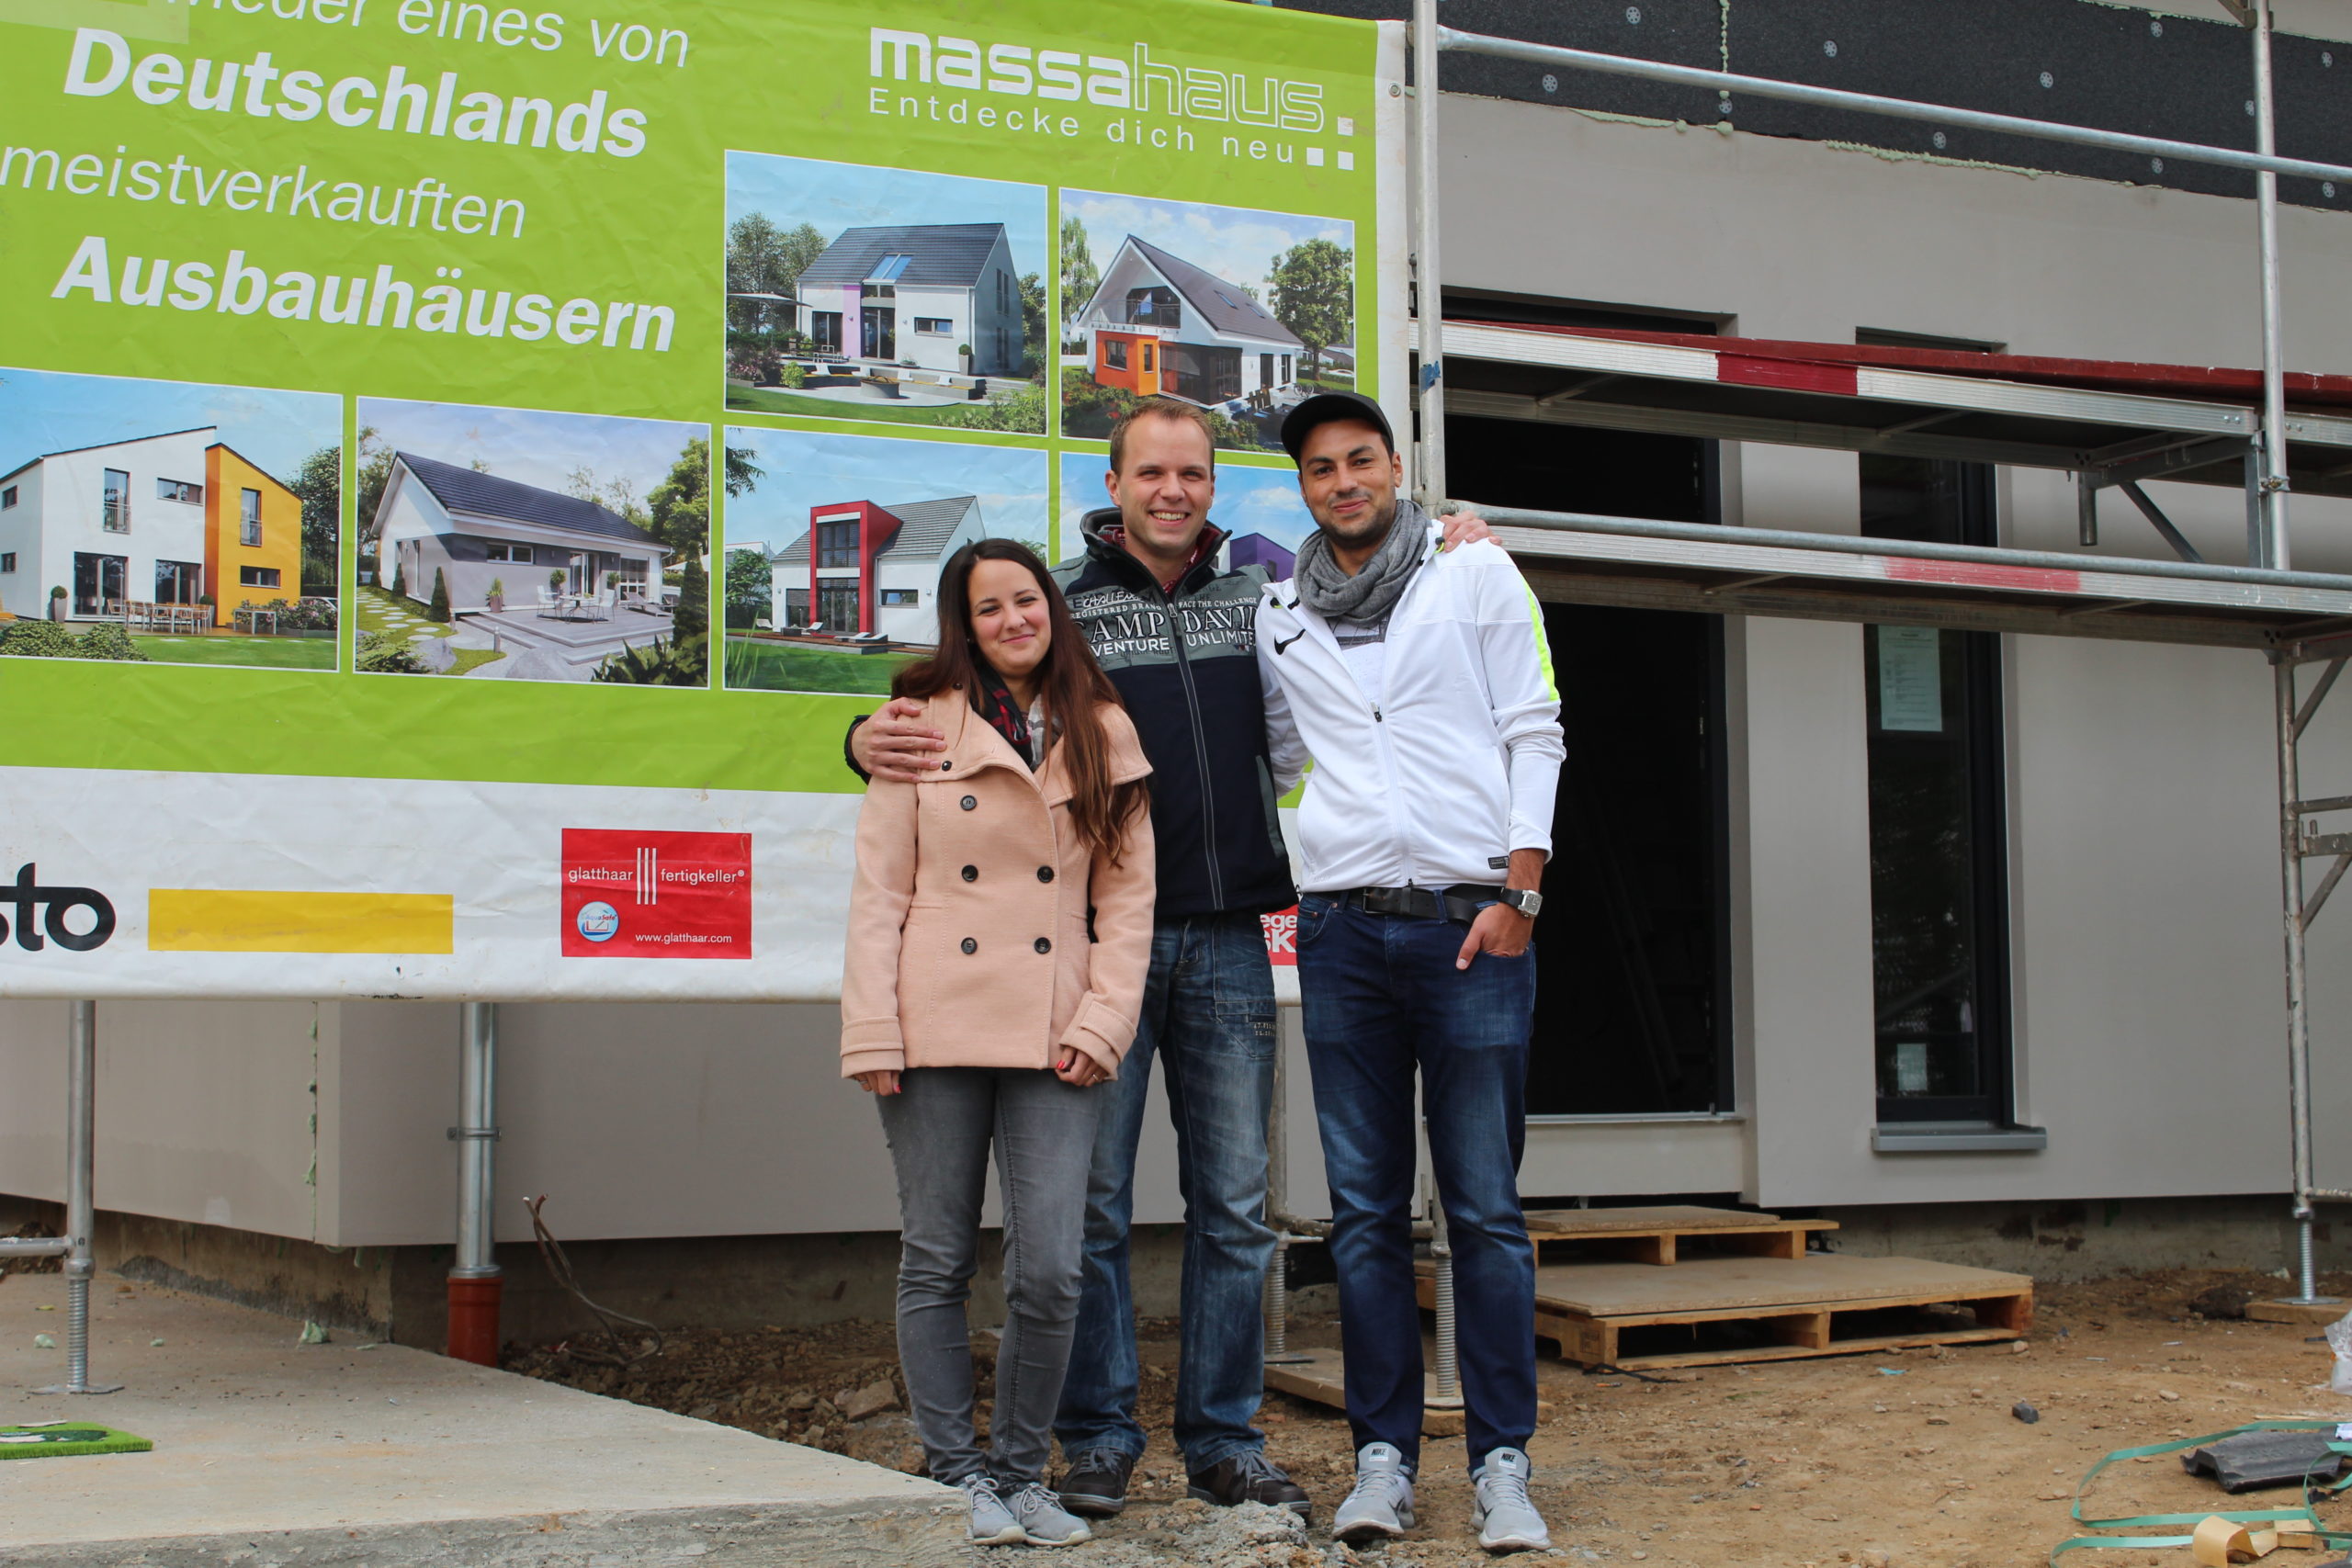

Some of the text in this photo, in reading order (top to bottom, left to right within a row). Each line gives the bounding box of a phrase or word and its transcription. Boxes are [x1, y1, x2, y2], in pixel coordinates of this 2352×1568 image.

[398, 0, 564, 51] eines
[591, 19, 689, 67] von
[870, 27, 1324, 133] massahaus
[63, 28, 647, 157] Deutschlands
[870, 87, 1293, 164] Entdecke dich neu
[0, 145, 526, 238] meistverkauften
[51, 235, 675, 352] Ausbauhäusern
[1070, 604, 1128, 619] REGISTERED
[1178, 600, 1196, 608] FACE
[1214, 596, 1258, 607] CHALLENGE
[1072, 611, 1166, 643] AMP
[1089, 637, 1170, 658] VENTURE
[1185, 630, 1256, 648] UNLIMITE
[568, 866, 634, 883] glatthaar
[0, 862, 117, 952] to
[1260, 913, 1298, 933] ege
[635, 931, 732, 945] www.glatthaar.com
[1371, 1448, 1387, 1456] NIKE
[1500, 1452, 1516, 1462] NIKE
